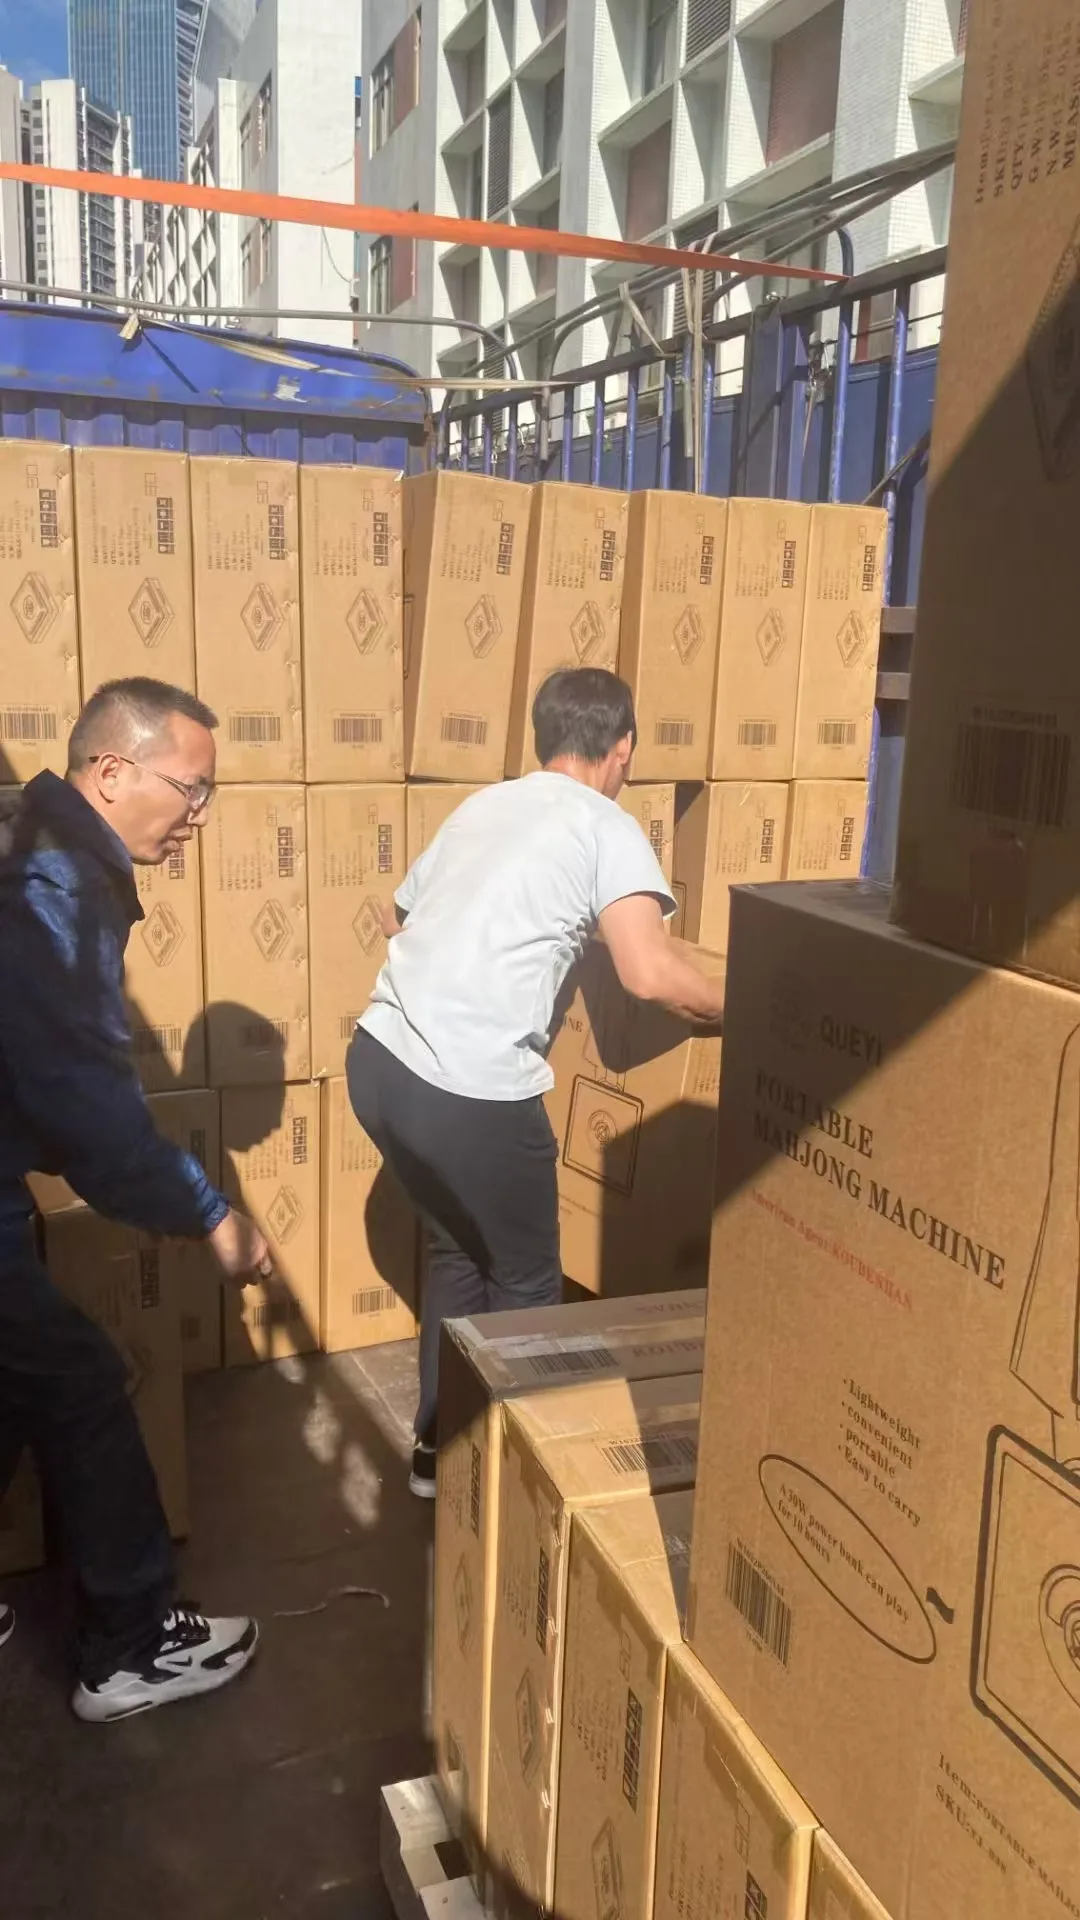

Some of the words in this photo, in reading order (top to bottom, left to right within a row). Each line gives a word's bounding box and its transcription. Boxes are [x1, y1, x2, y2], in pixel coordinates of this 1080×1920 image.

[820, 1014, 883, 1067] QUEYI
[756, 1068, 874, 1159] PORTABLE
[754, 1111, 862, 1201] MAHJONG
[868, 1179, 1006, 1291] MACHINE
[847, 1404, 913, 1470] convenient
[848, 1378, 921, 1449] Lightweight
[844, 1445, 871, 1482] Easy
[873, 1475, 886, 1494] to
[888, 1491, 921, 1528] carry
[845, 1427, 896, 1478] portable
[778, 1499, 791, 1519] for
[792, 1515, 803, 1533] 10
[804, 1526, 831, 1563] hours
[808, 1514, 838, 1548] power
[839, 1540, 864, 1577] bank
[865, 1572, 884, 1597] can
[885, 1592, 910, 1623] play
